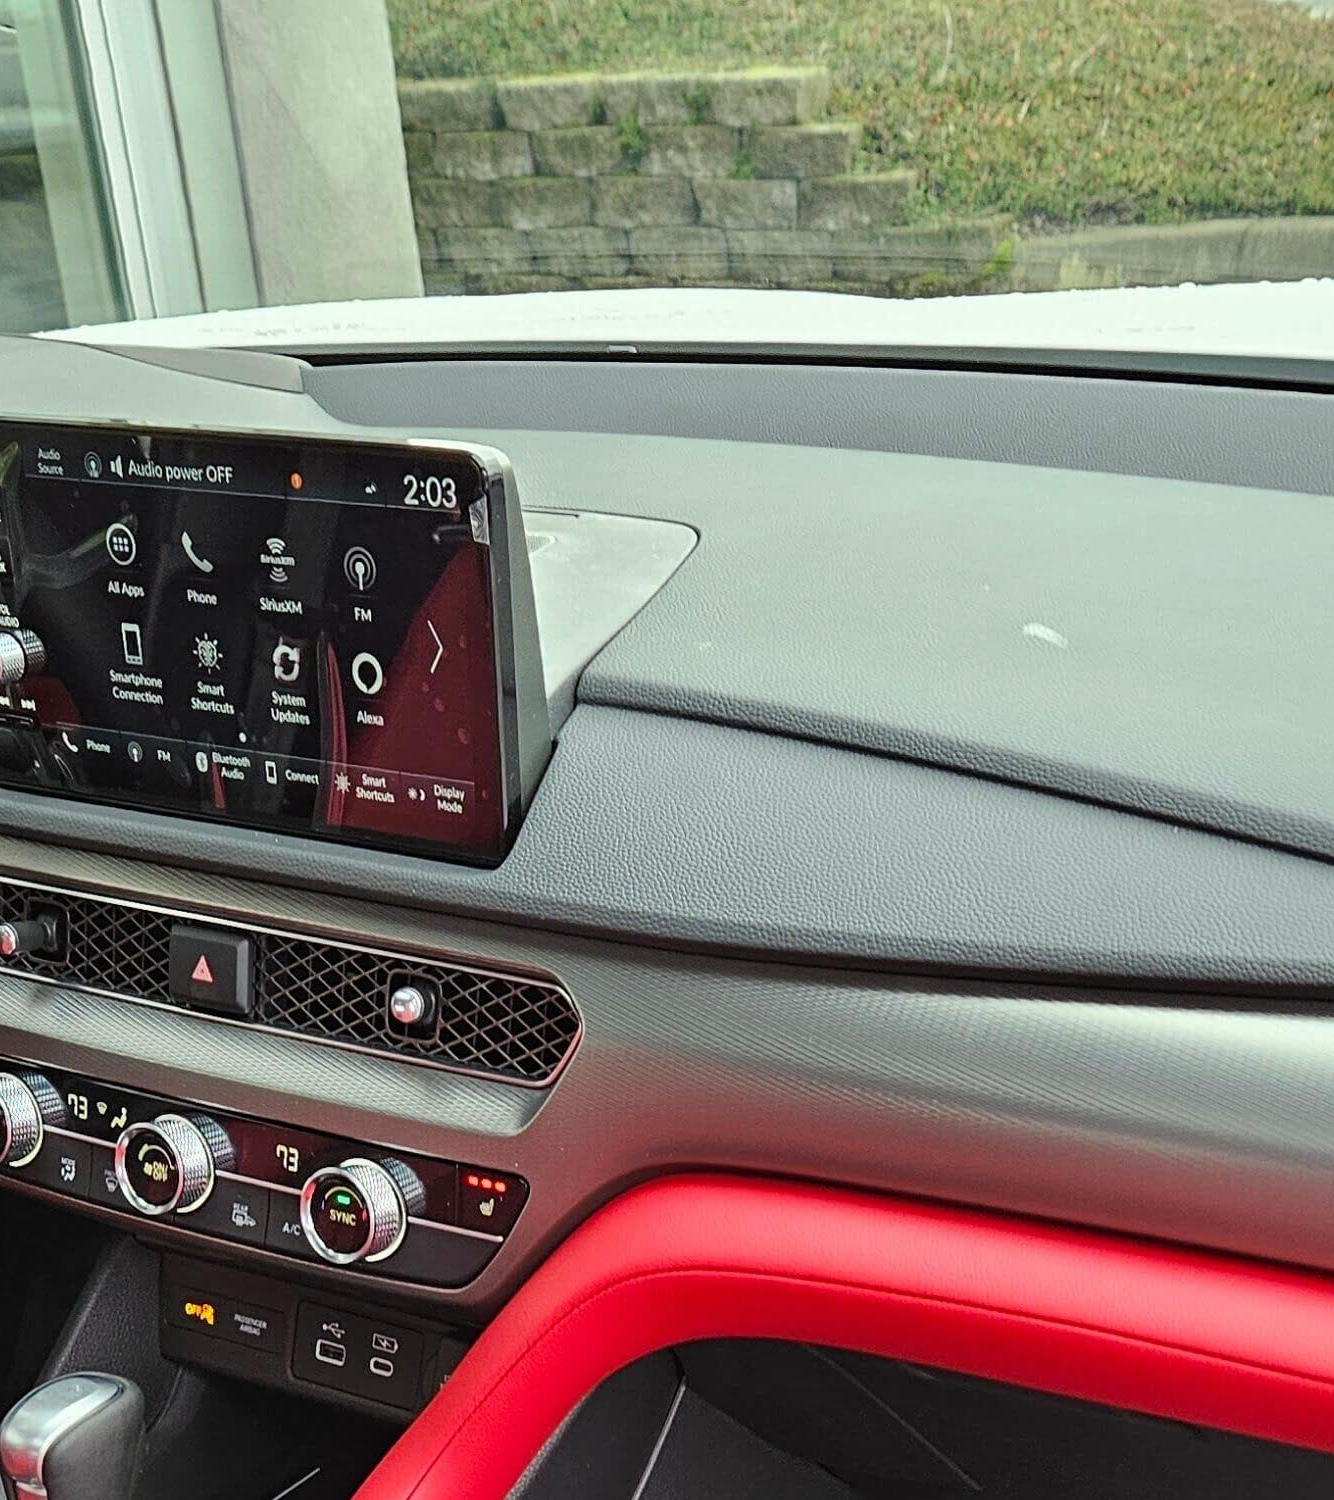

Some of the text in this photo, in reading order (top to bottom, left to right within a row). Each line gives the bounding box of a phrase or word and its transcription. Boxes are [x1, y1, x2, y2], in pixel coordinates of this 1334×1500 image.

[37, 447, 61, 462] Audio
[37, 462, 64, 477] Source
[128, 458, 234, 484] Audio power OFF
[403, 474, 457, 508] 2:03
[107, 580, 145, 598] All Apps
[187, 588, 217, 606] Phone
[259, 597, 303, 615] SiriusXM
[354, 606, 372, 622] FM
[109, 669, 163, 689] Smartphone
[112, 686, 163, 706] Connection
[197, 681, 225, 697] Smart
[190, 697, 235, 716] Shortcuts
[270, 690, 306, 709] System
[270, 707, 310, 727] Updates
[356, 709, 384, 728] Alexa
[86, 738, 111, 754] Phone
[157, 749, 171, 763] FM
[211, 751, 251, 769] Bluetooth
[220, 765, 245, 781] Audio
[285, 768, 319, 785] Connect
[361, 772, 387, 789] Smart
[355, 786, 395, 804] Shortcuts
[433, 783, 465, 803] Display
[437, 799, 463, 815] Mode
[68, 1092, 88, 1121] 73
[276, 1143, 300, 1174] 73
[328, 1207, 357, 1227] SYNC
[281, 1222, 301, 1237] A/C
